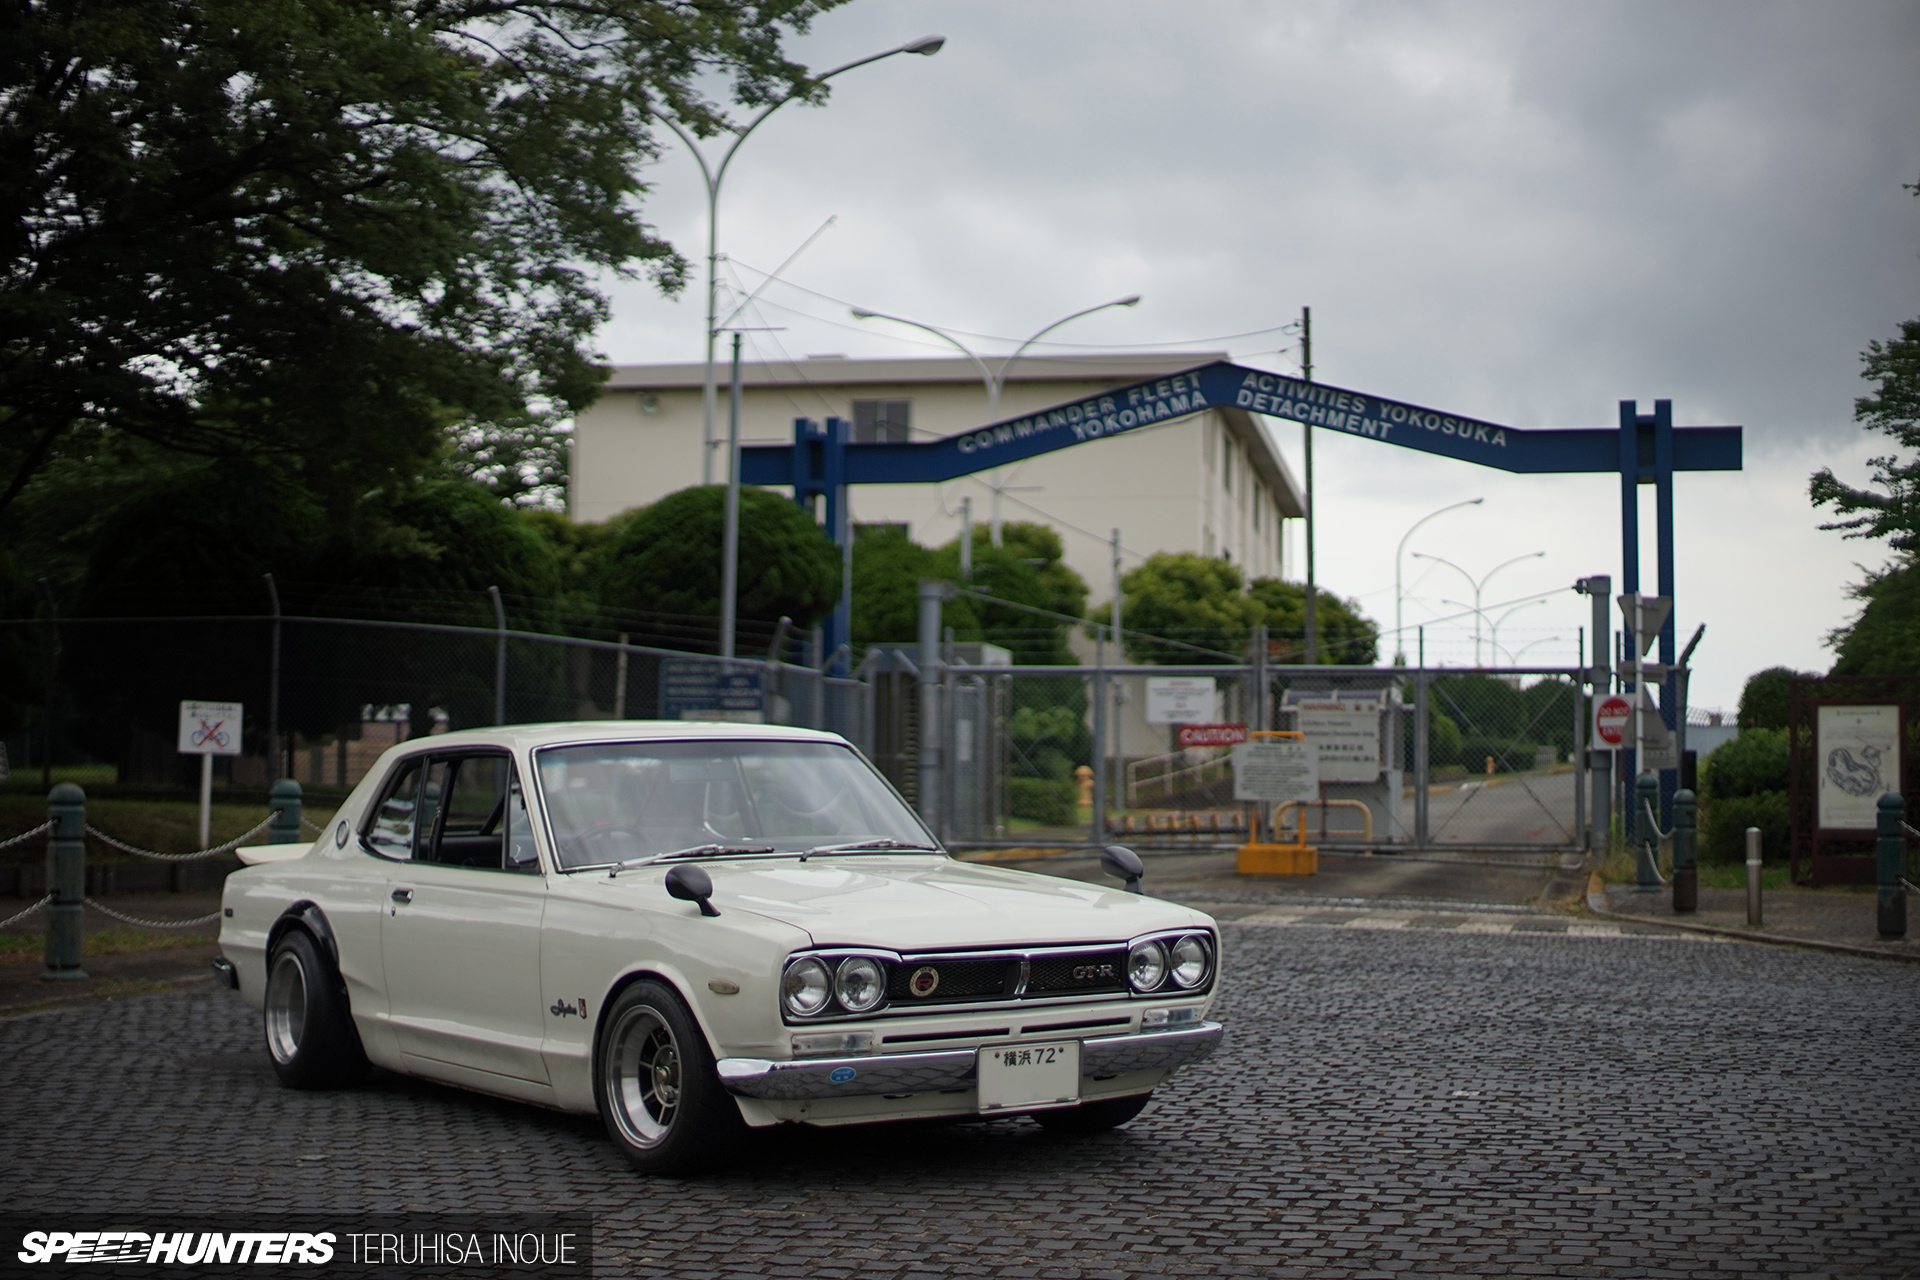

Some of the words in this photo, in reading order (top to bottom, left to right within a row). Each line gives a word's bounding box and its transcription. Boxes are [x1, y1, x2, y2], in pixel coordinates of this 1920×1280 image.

[957, 396, 1117, 454] COMMANDER
[1127, 372, 1202, 406] FLEET
[1241, 371, 1368, 414] ACTIVITIES
[1379, 401, 1507, 447] YOKOSUKA
[1070, 390, 1208, 442] YOKOHAMA
[1236, 388, 1393, 439] DETACHMENT
[1600, 707, 1611, 716] DO
[1613, 706, 1628, 716] NOT
[1181, 728, 1246, 744] CAUTION
[1602, 726, 1623, 736] ENTE
[1073, 964, 1114, 979] GT-R
[1003, 1049, 1031, 1067] 横浜
[1035, 1047, 1056, 1064] 72
